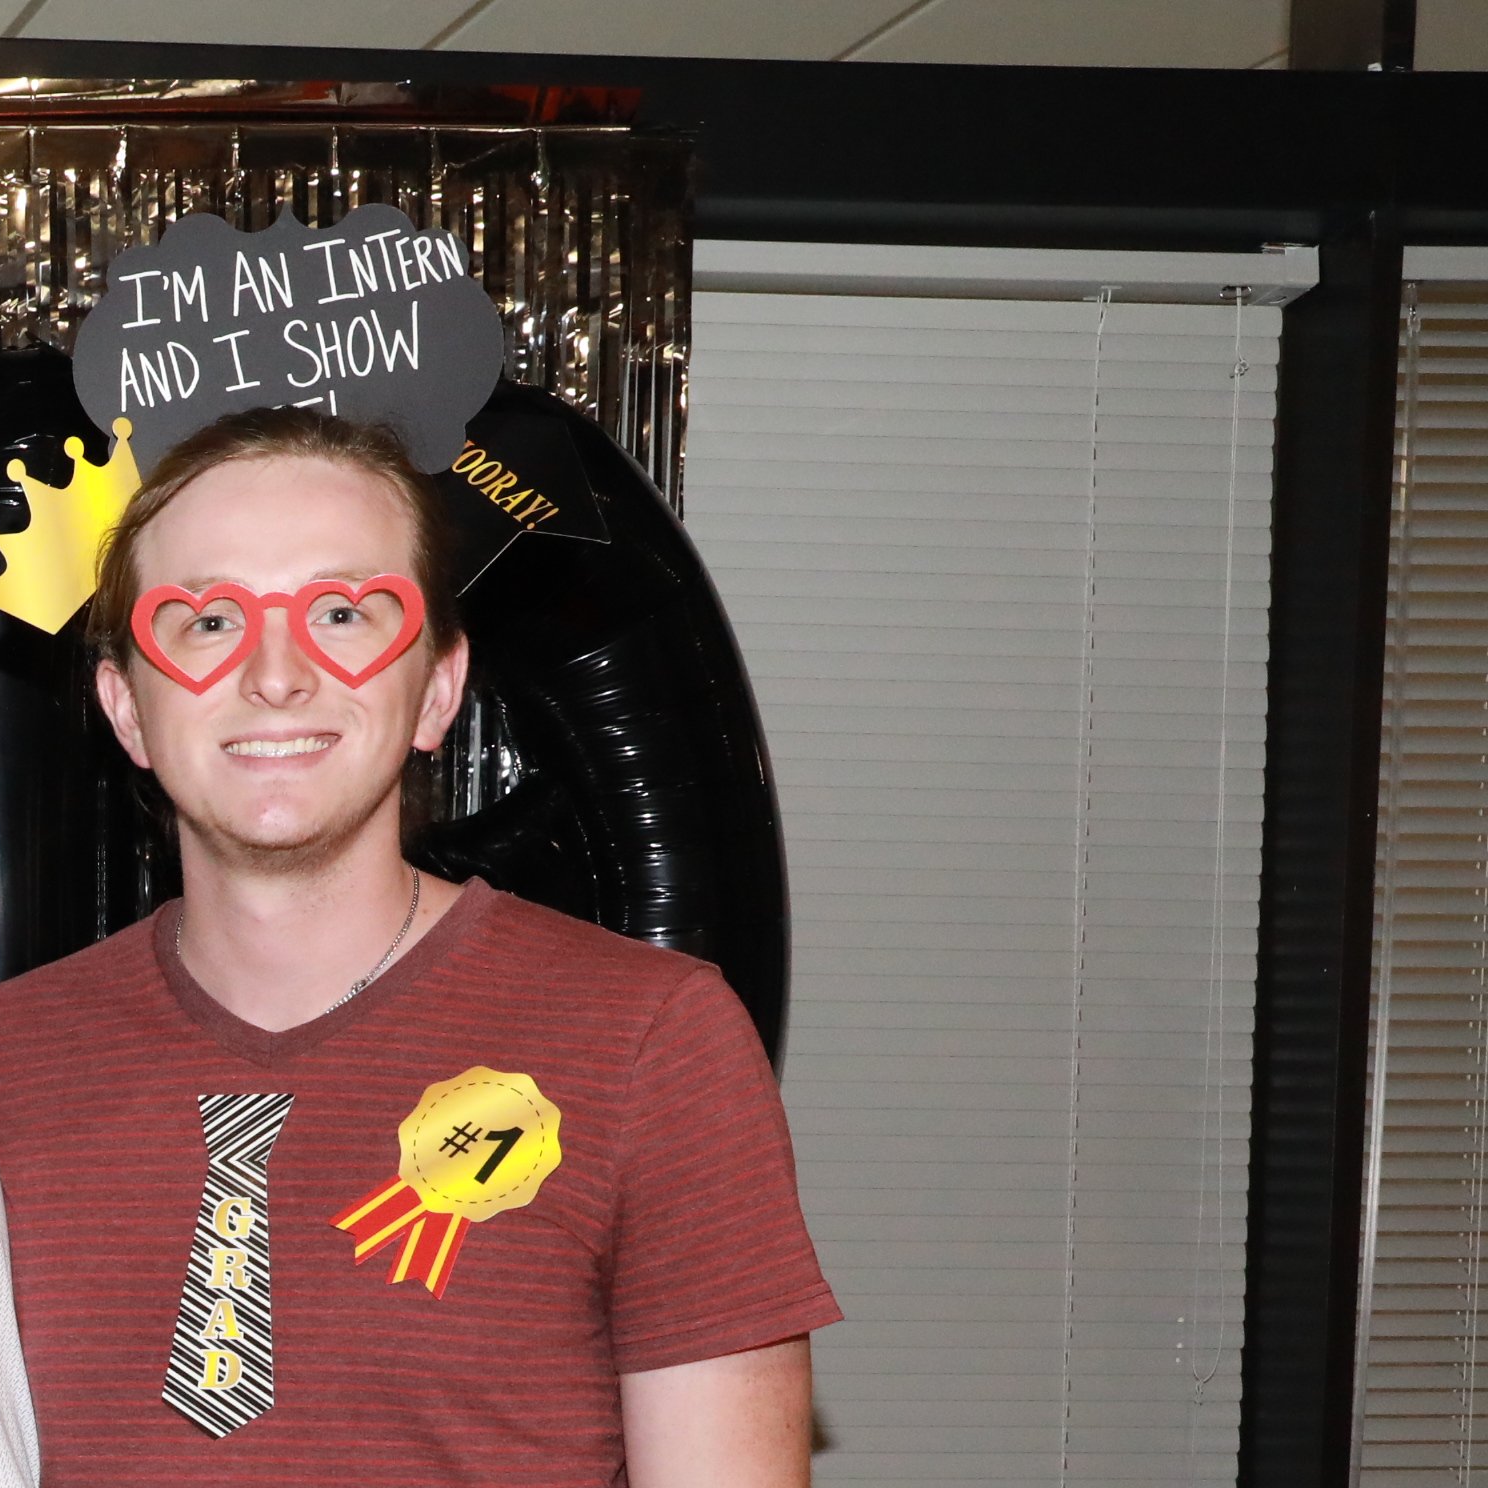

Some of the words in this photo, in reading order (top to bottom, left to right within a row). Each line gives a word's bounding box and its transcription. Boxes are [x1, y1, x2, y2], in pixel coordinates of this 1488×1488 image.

[118, 265, 209, 331] I'M
[232, 252, 294, 317] AN
[303, 228, 465, 305] INTERN
[119, 340, 200, 412] AND
[213, 329, 262, 391] I
[285, 300, 421, 388] SHOW
[451, 439, 560, 530] OORAY!
[438, 1121, 524, 1185] #1
[198, 1196, 254, 1390] GRAD
